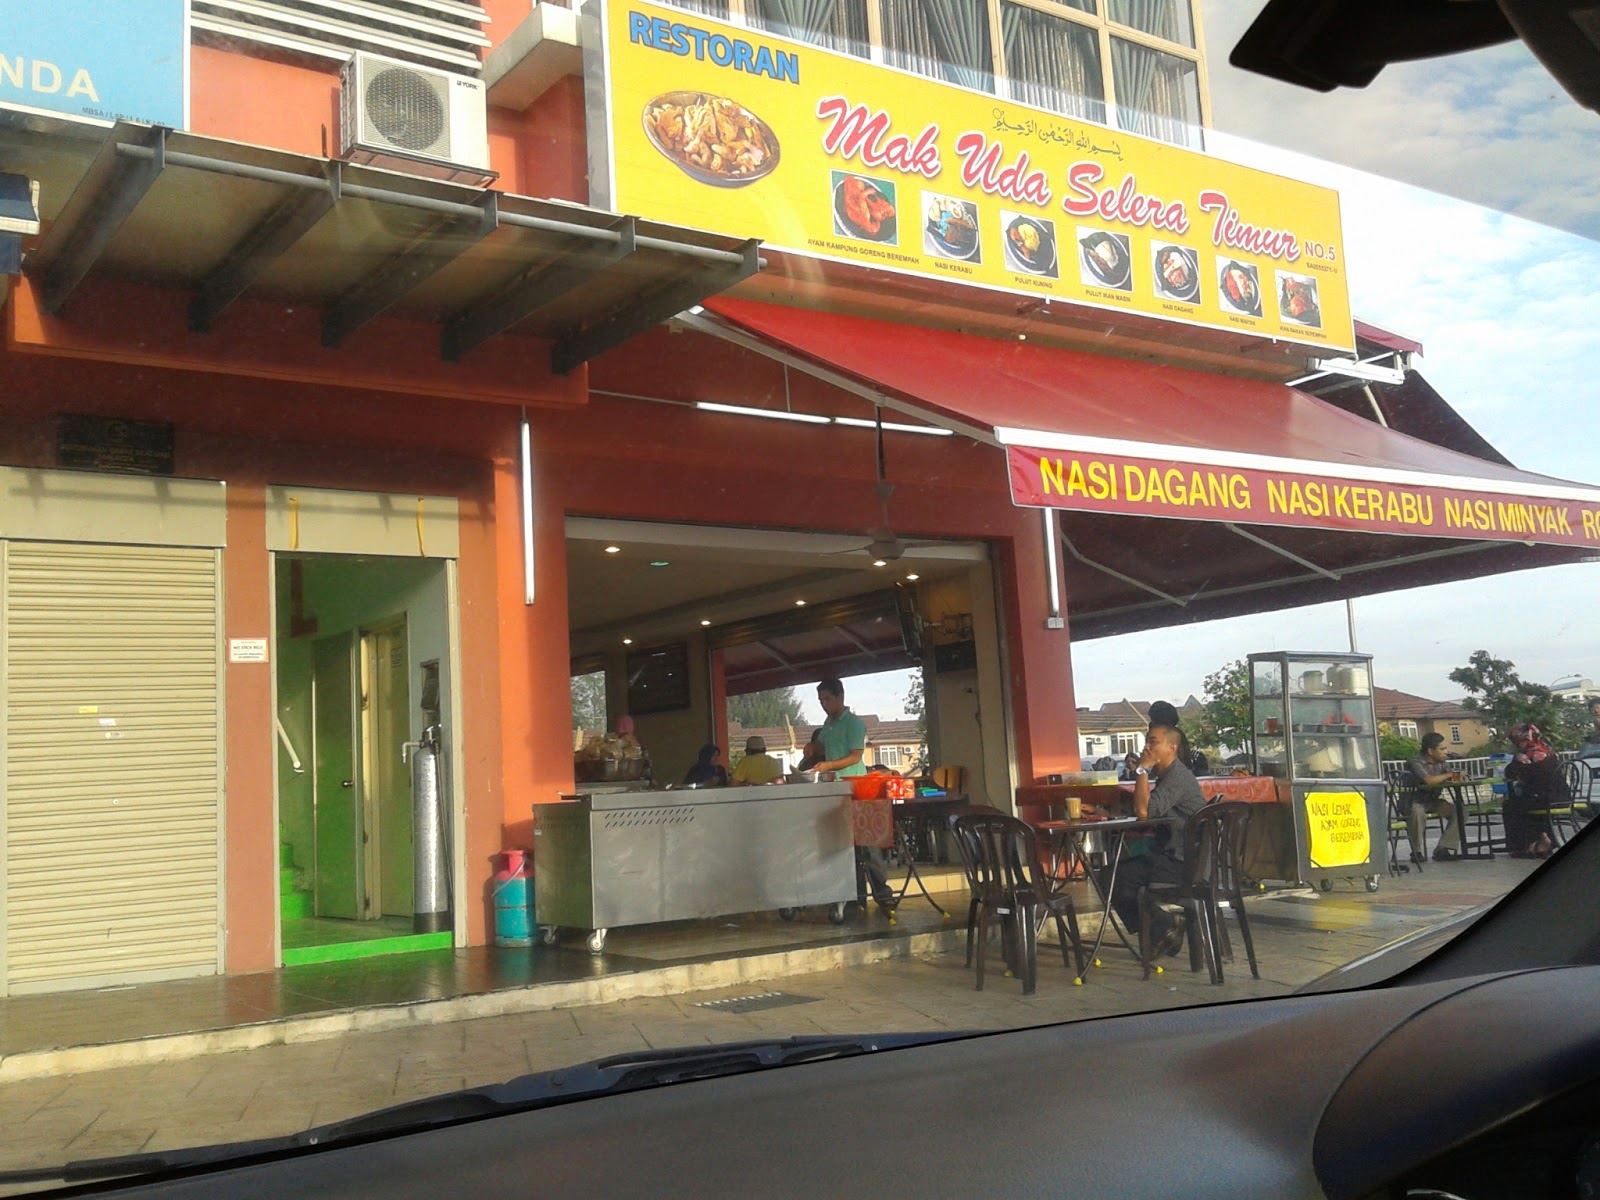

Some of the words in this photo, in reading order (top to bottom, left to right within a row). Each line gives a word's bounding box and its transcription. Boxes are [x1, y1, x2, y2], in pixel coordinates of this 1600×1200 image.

[629, 11, 800, 85] RESTORAN
[817, 96, 941, 177] Mak
[956, 132, 1051, 207] Uda
[1063, 162, 1190, 235] Selera
[1199, 190, 1302, 261] Timur
[1305, 241, 1335, 261] NO.5
[807, 238, 825, 247] AYAM
[826, 240, 858, 253] KAMPUNG
[859, 248, 886, 258] GORENG
[887, 252, 919, 264] BEREMPAH
[934, 262, 949, 270] NASI
[949, 265, 973, 274] KERABU
[1014, 276, 1032, 285] PULUT
[1032, 280, 1053, 289] KUNING
[1085, 289, 1102, 298] PULUT
[1162, 303, 1174, 311] NASI
[1040, 457, 1117, 500] NASI
[1123, 465, 1251, 510] DAGANG
[1267, 479, 1330, 517] NASI
[1333, 485, 1433, 526] KERABU
[1444, 497, 1496, 531] NASI
[1498, 501, 1573, 536] MINYAK
